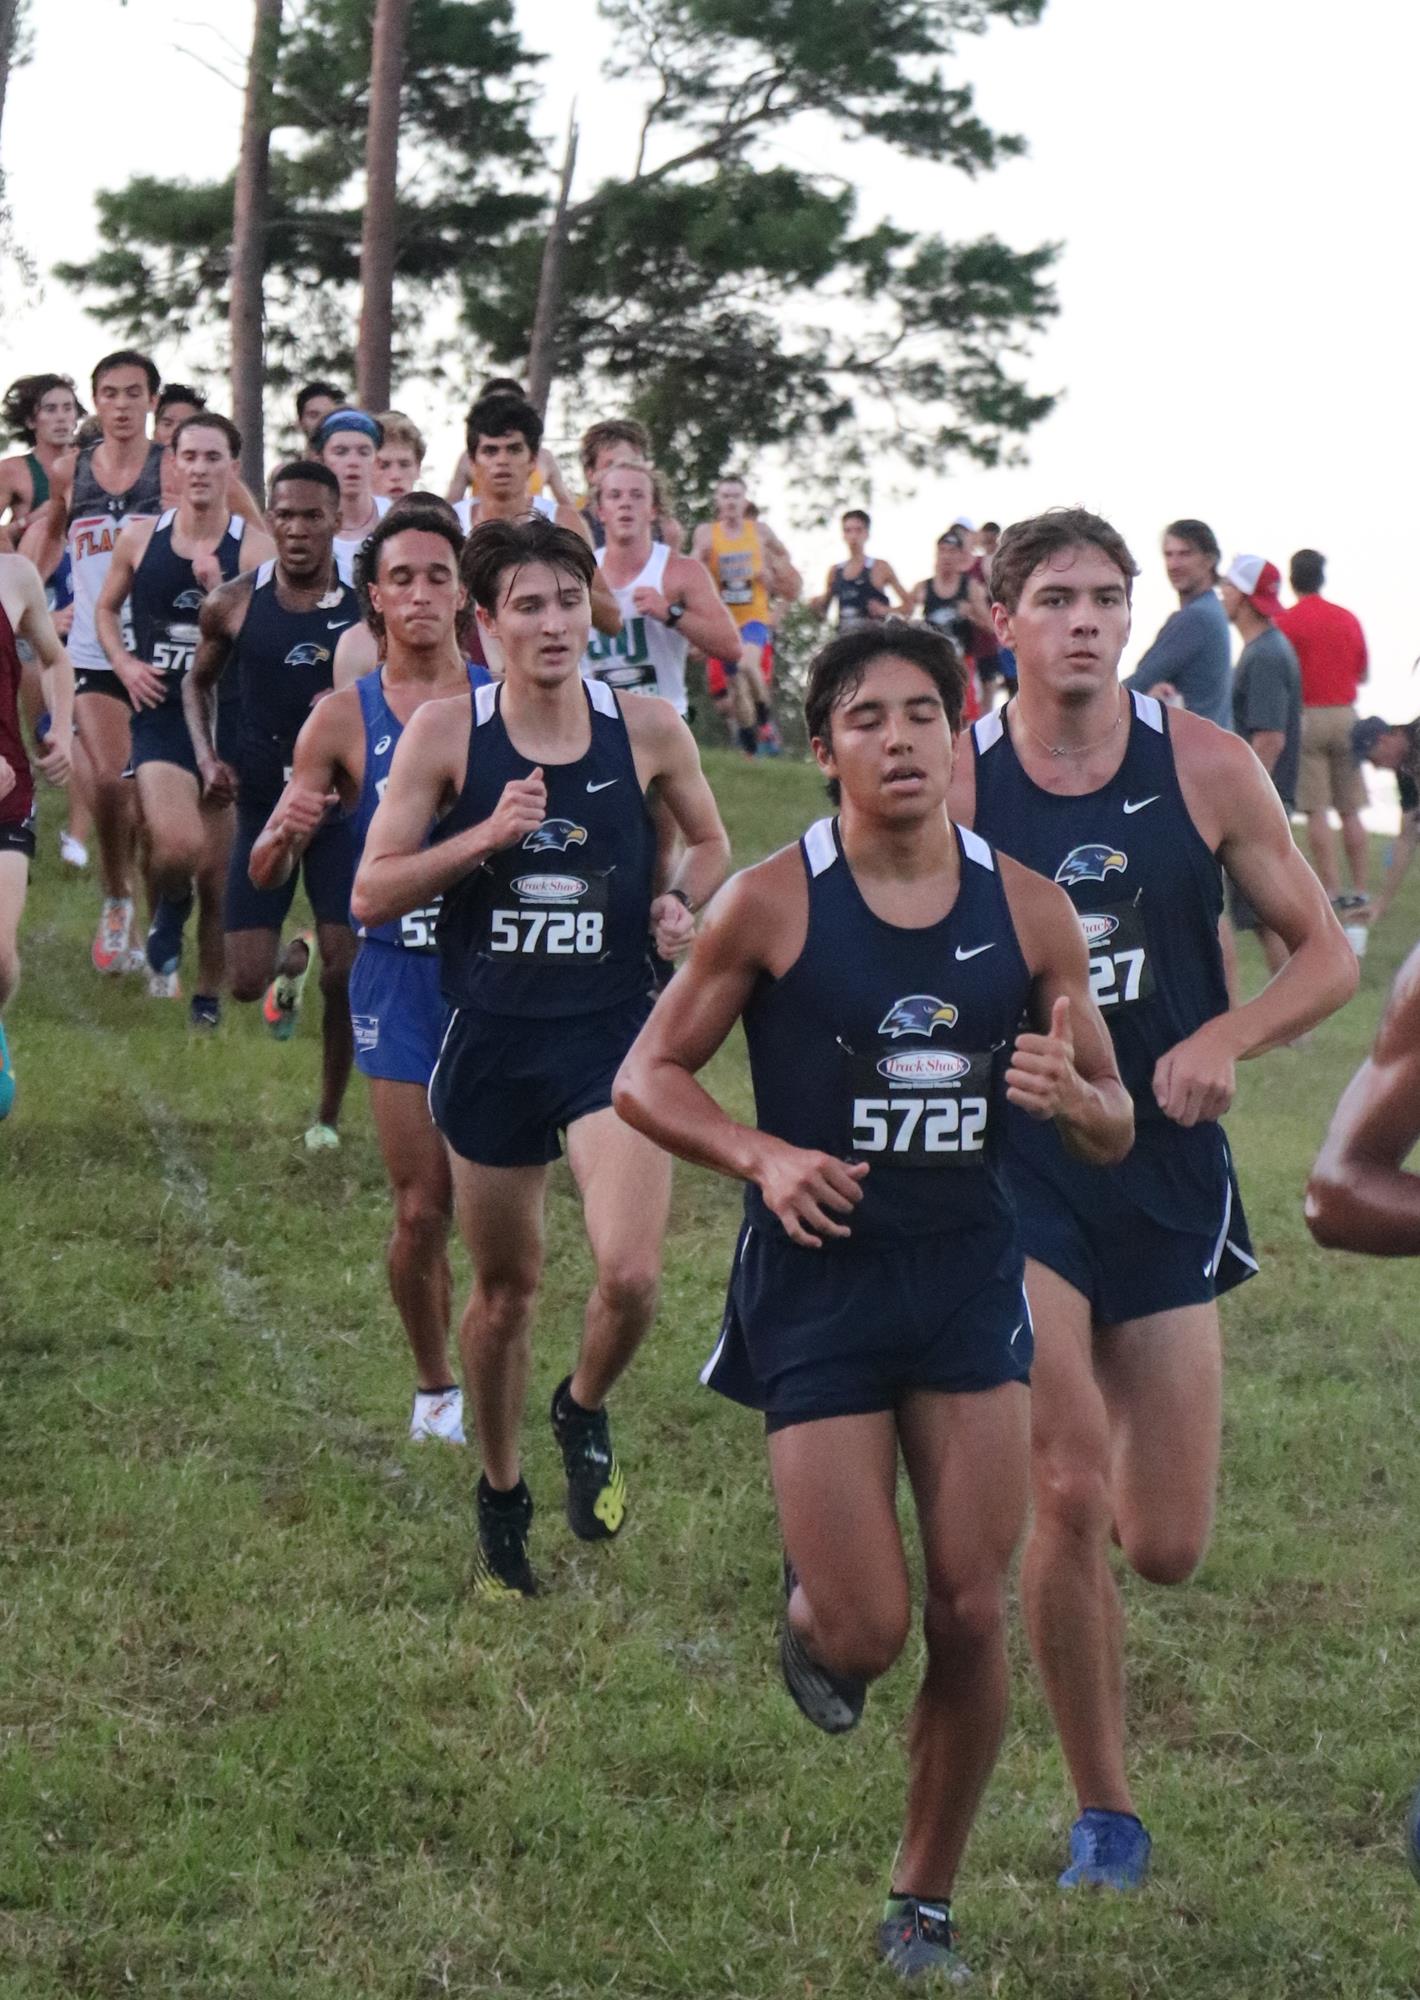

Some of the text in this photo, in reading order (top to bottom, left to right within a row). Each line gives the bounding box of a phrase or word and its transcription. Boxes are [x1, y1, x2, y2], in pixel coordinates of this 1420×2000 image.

[491, 909, 604, 954] 5728
[1082, 917, 1111, 933] hack
[887, 1058, 964, 1073] Track Shack
[852, 1097, 988, 1152] 5722
